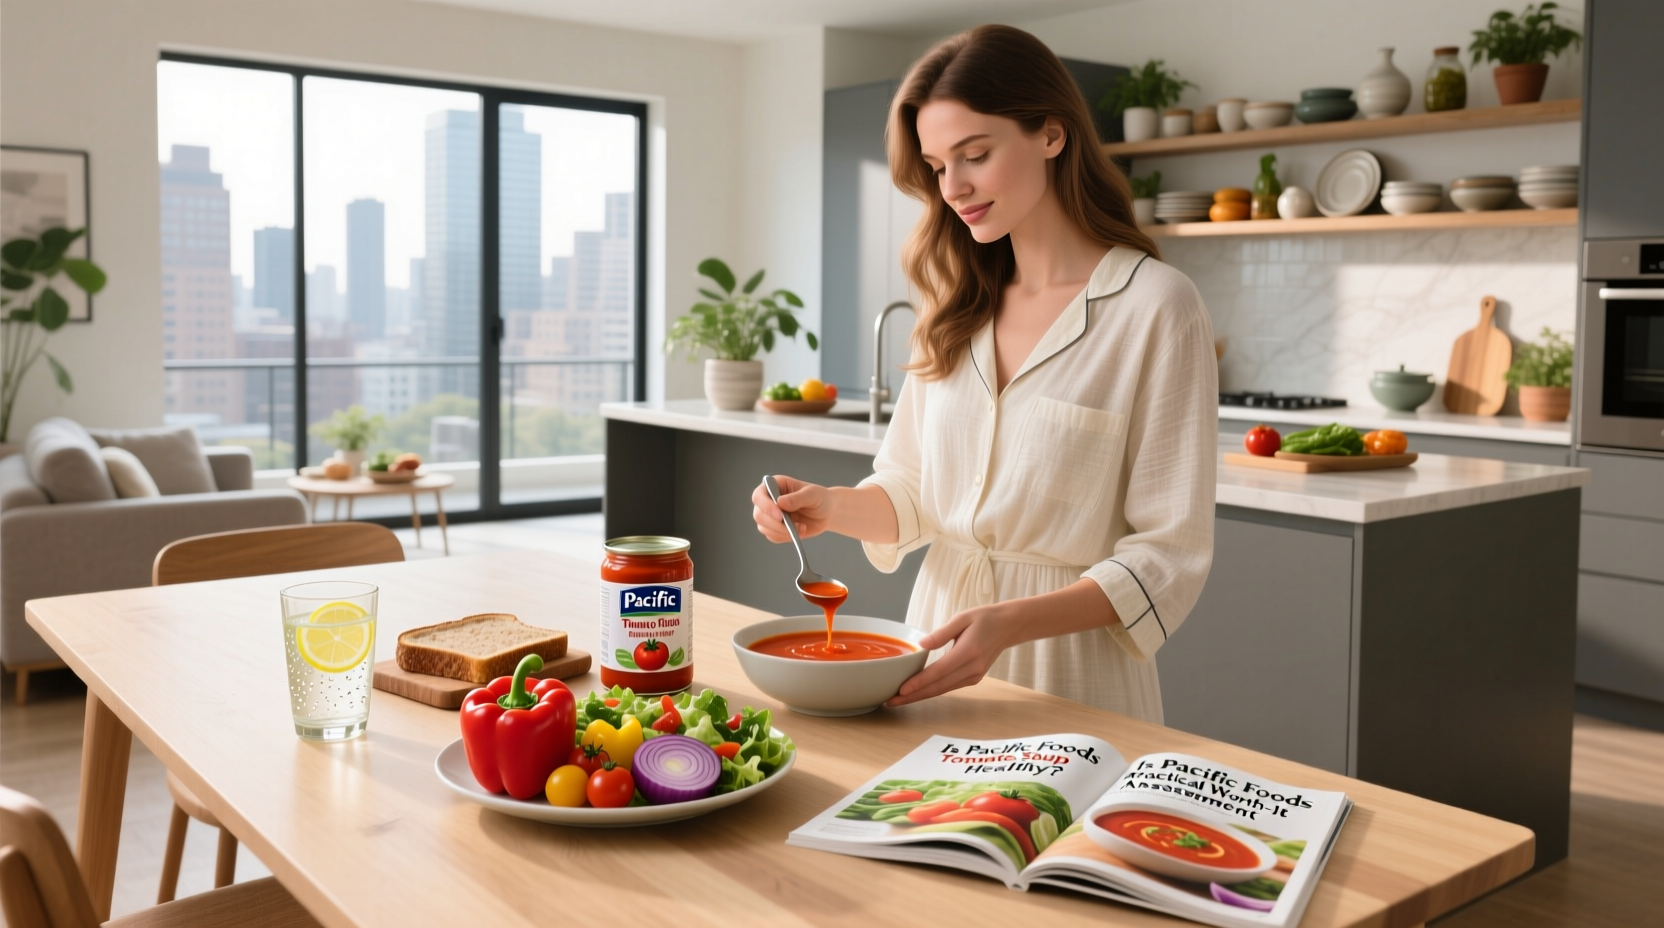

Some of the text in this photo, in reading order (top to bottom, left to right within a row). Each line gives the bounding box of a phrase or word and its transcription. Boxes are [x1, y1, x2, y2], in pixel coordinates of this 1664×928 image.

[624, 591, 676, 608] Pacific
[965, 742, 1031, 755] Pacific
[1037, 741, 1101, 765] Foods
[1160, 759, 1238, 788] Pacific
[1243, 782, 1313, 809] Foods
[1211, 783, 1289, 818] Worth-It
